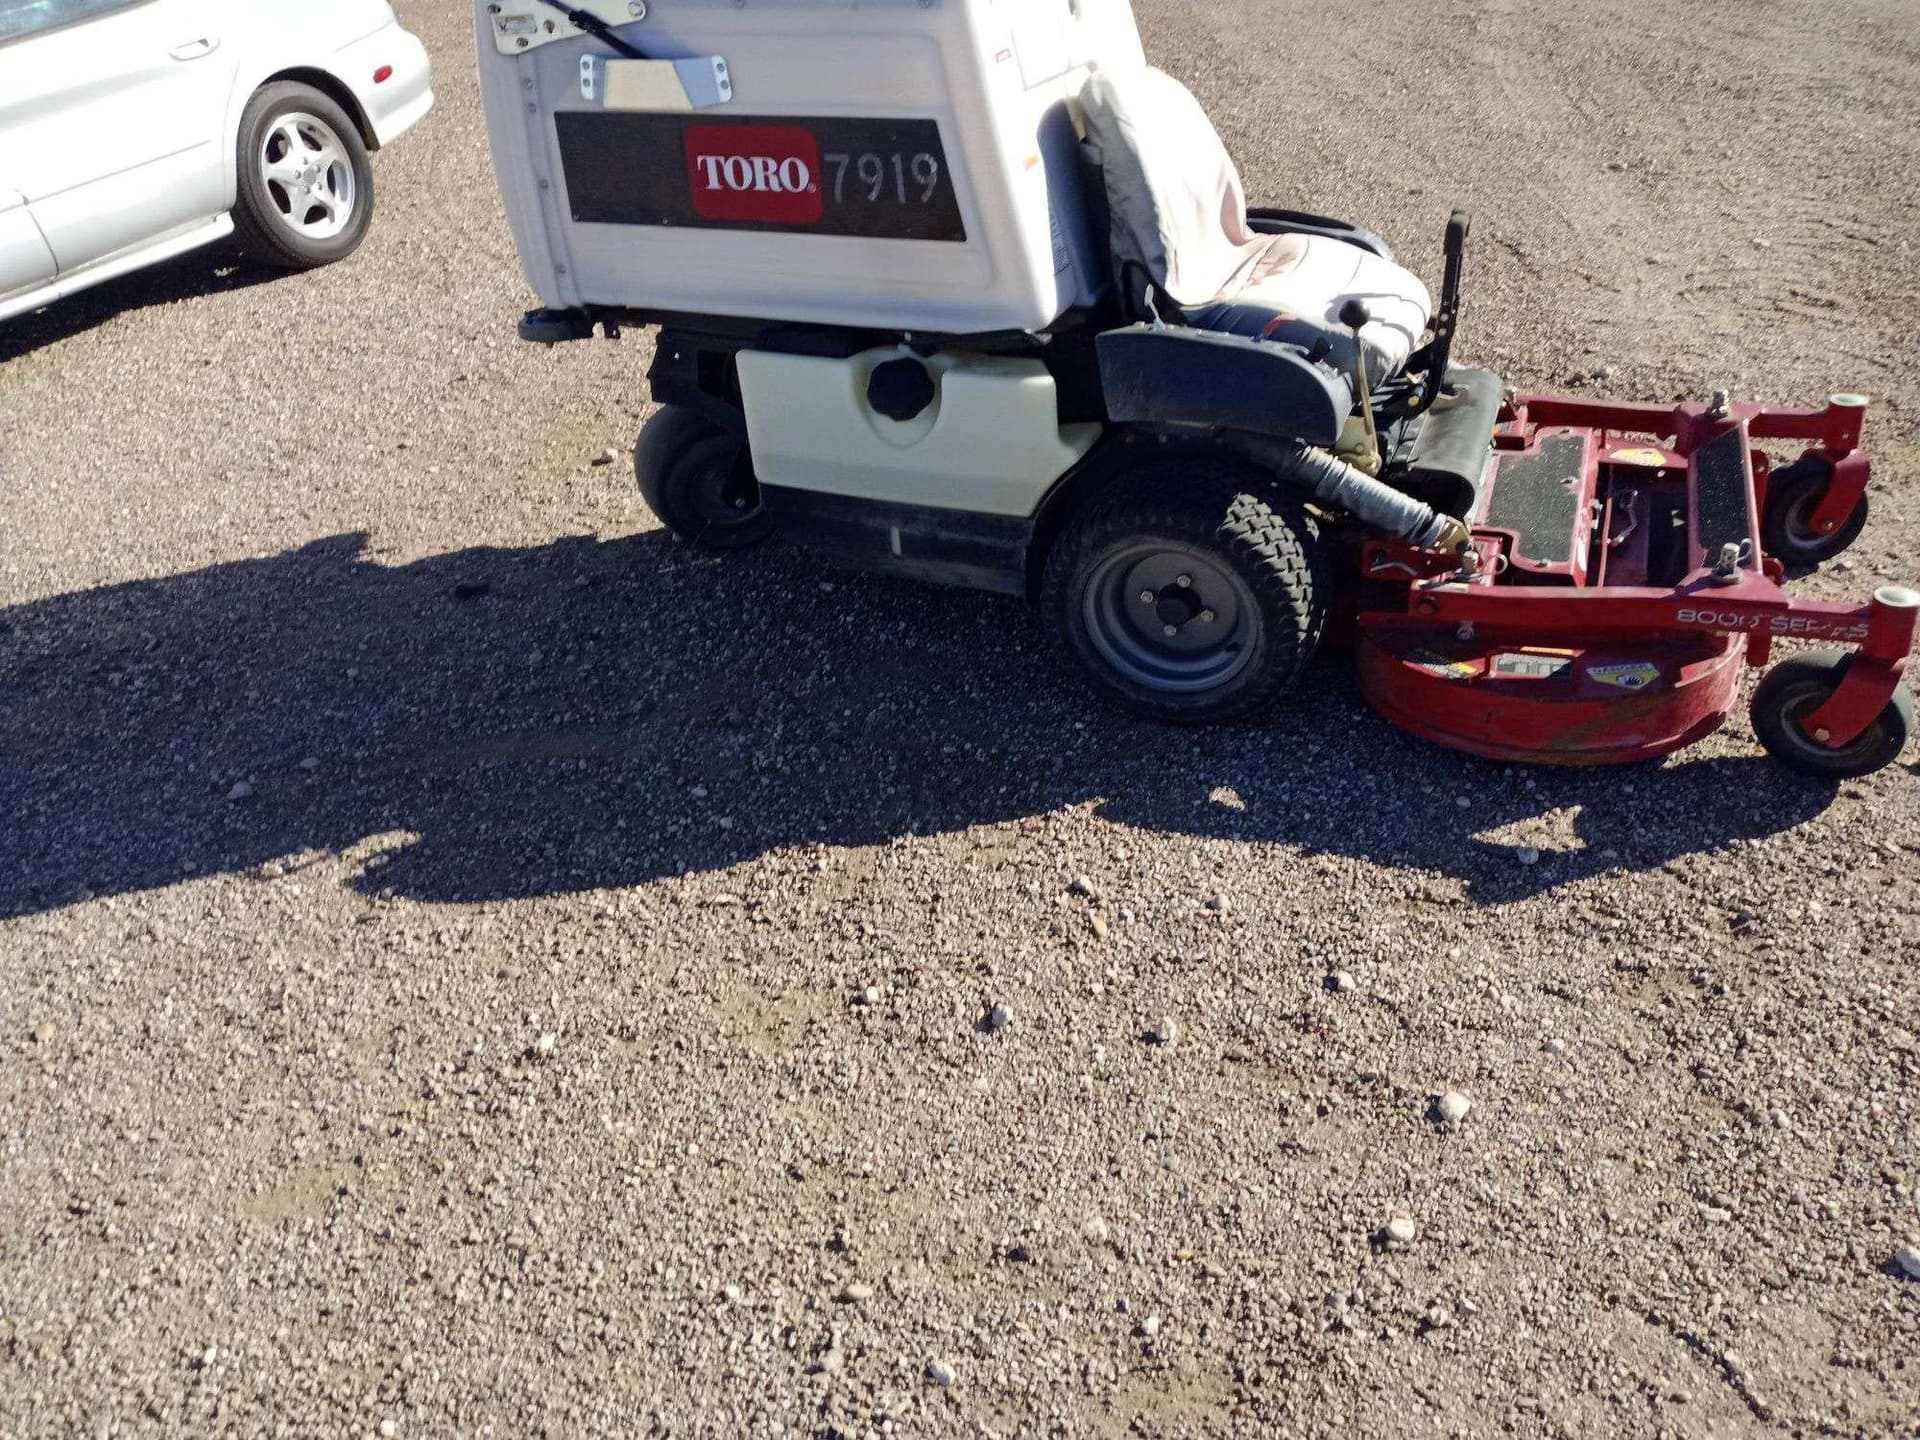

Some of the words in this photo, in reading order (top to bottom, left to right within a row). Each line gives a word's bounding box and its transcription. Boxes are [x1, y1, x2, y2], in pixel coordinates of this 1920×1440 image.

[697, 155, 810, 193] TORO
[824, 152, 939, 204] 7919
[1769, 614, 1870, 638] SERS
